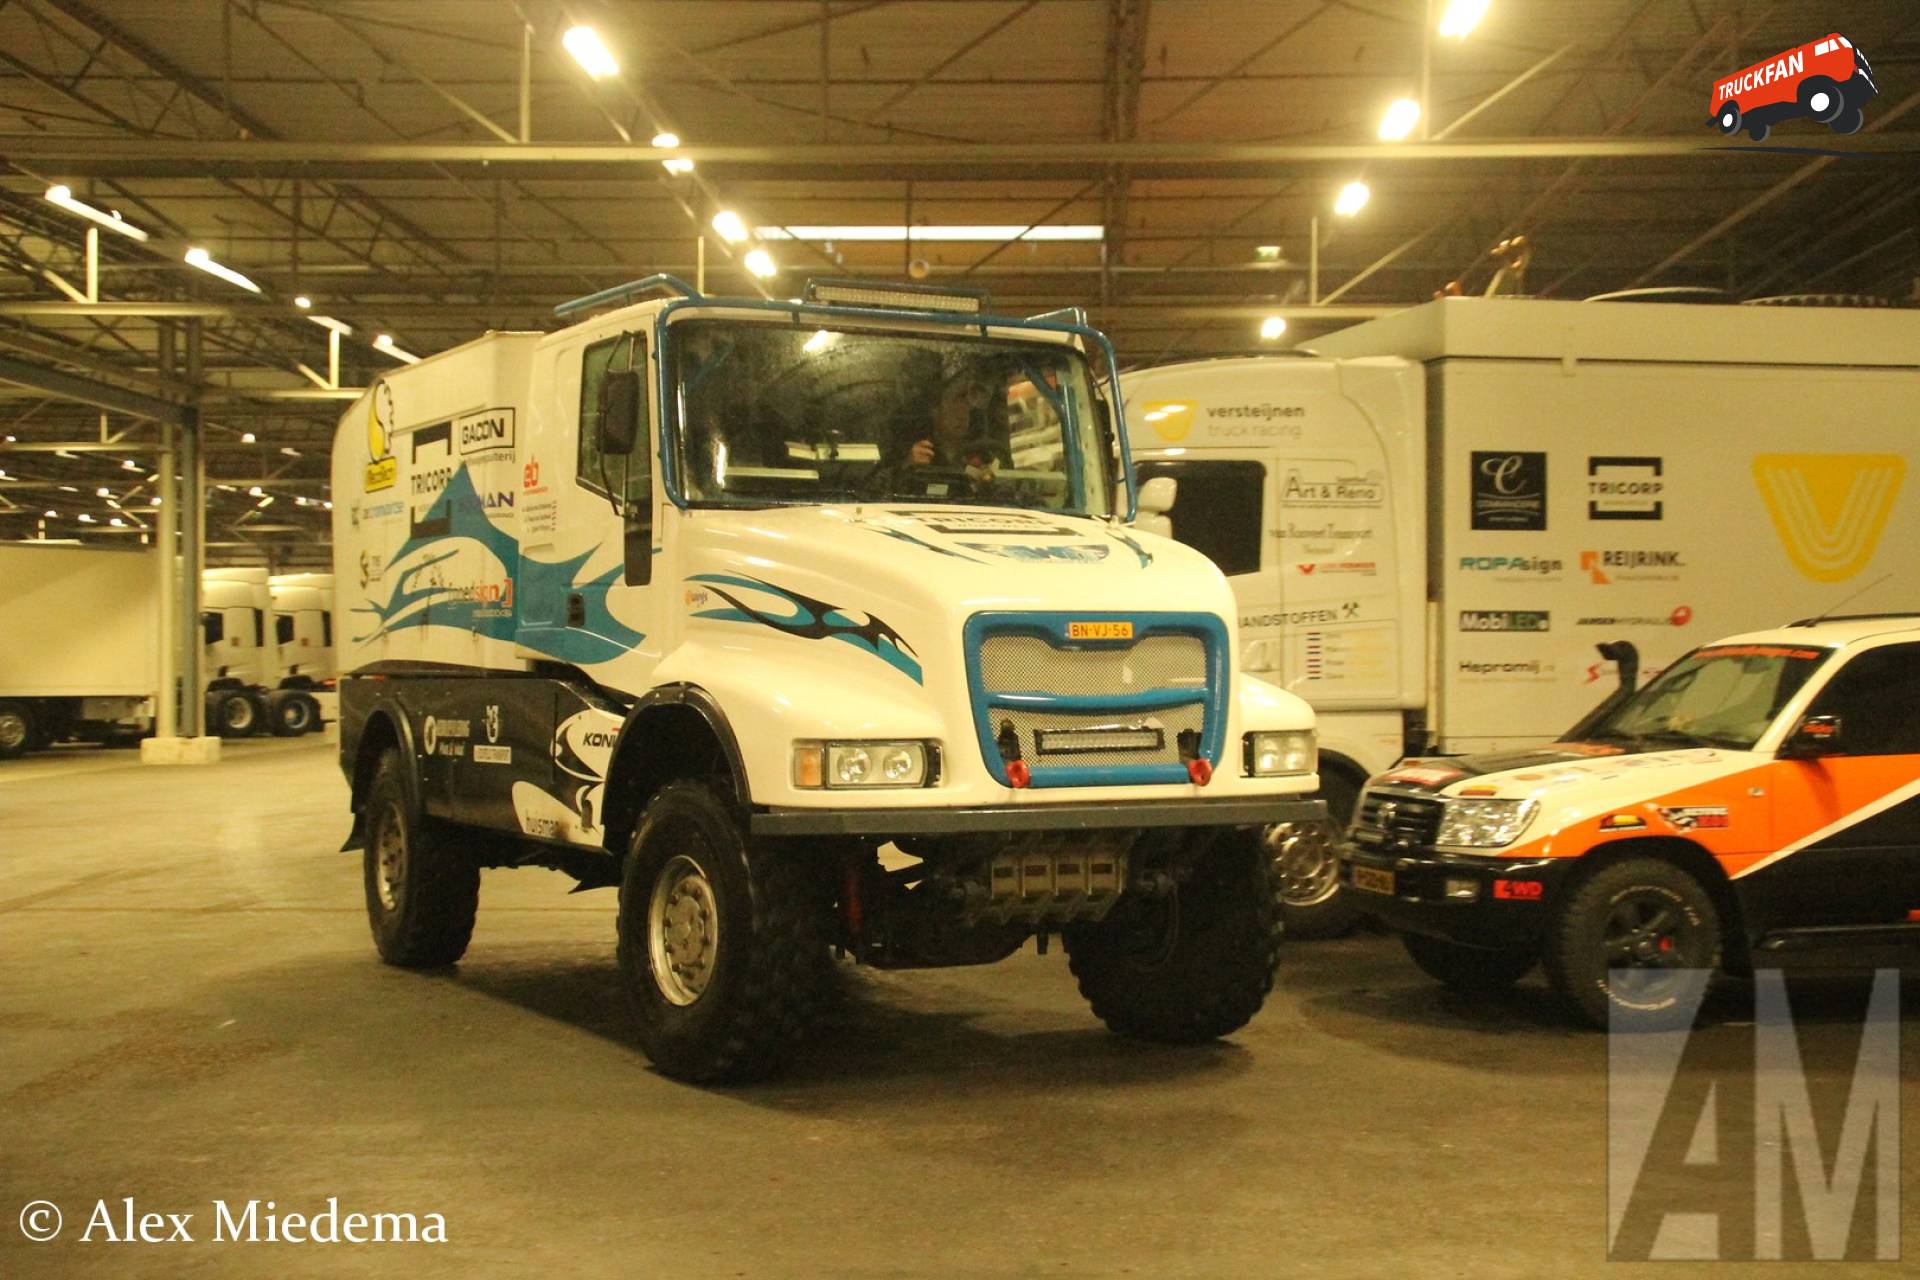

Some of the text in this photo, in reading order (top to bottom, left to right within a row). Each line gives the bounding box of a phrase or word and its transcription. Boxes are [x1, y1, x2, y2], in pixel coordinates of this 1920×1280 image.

[1207, 403, 1306, 421] versteijnen
[462, 417, 504, 445] GACON
[1207, 424, 1302, 440] truck racing
[411, 467, 452, 497] TRICORP
[1285, 476, 1375, 499] Art & Reno
[1589, 482, 1663, 495] TRICORP
[1071, 622, 1129, 637] BN-VJ-56
